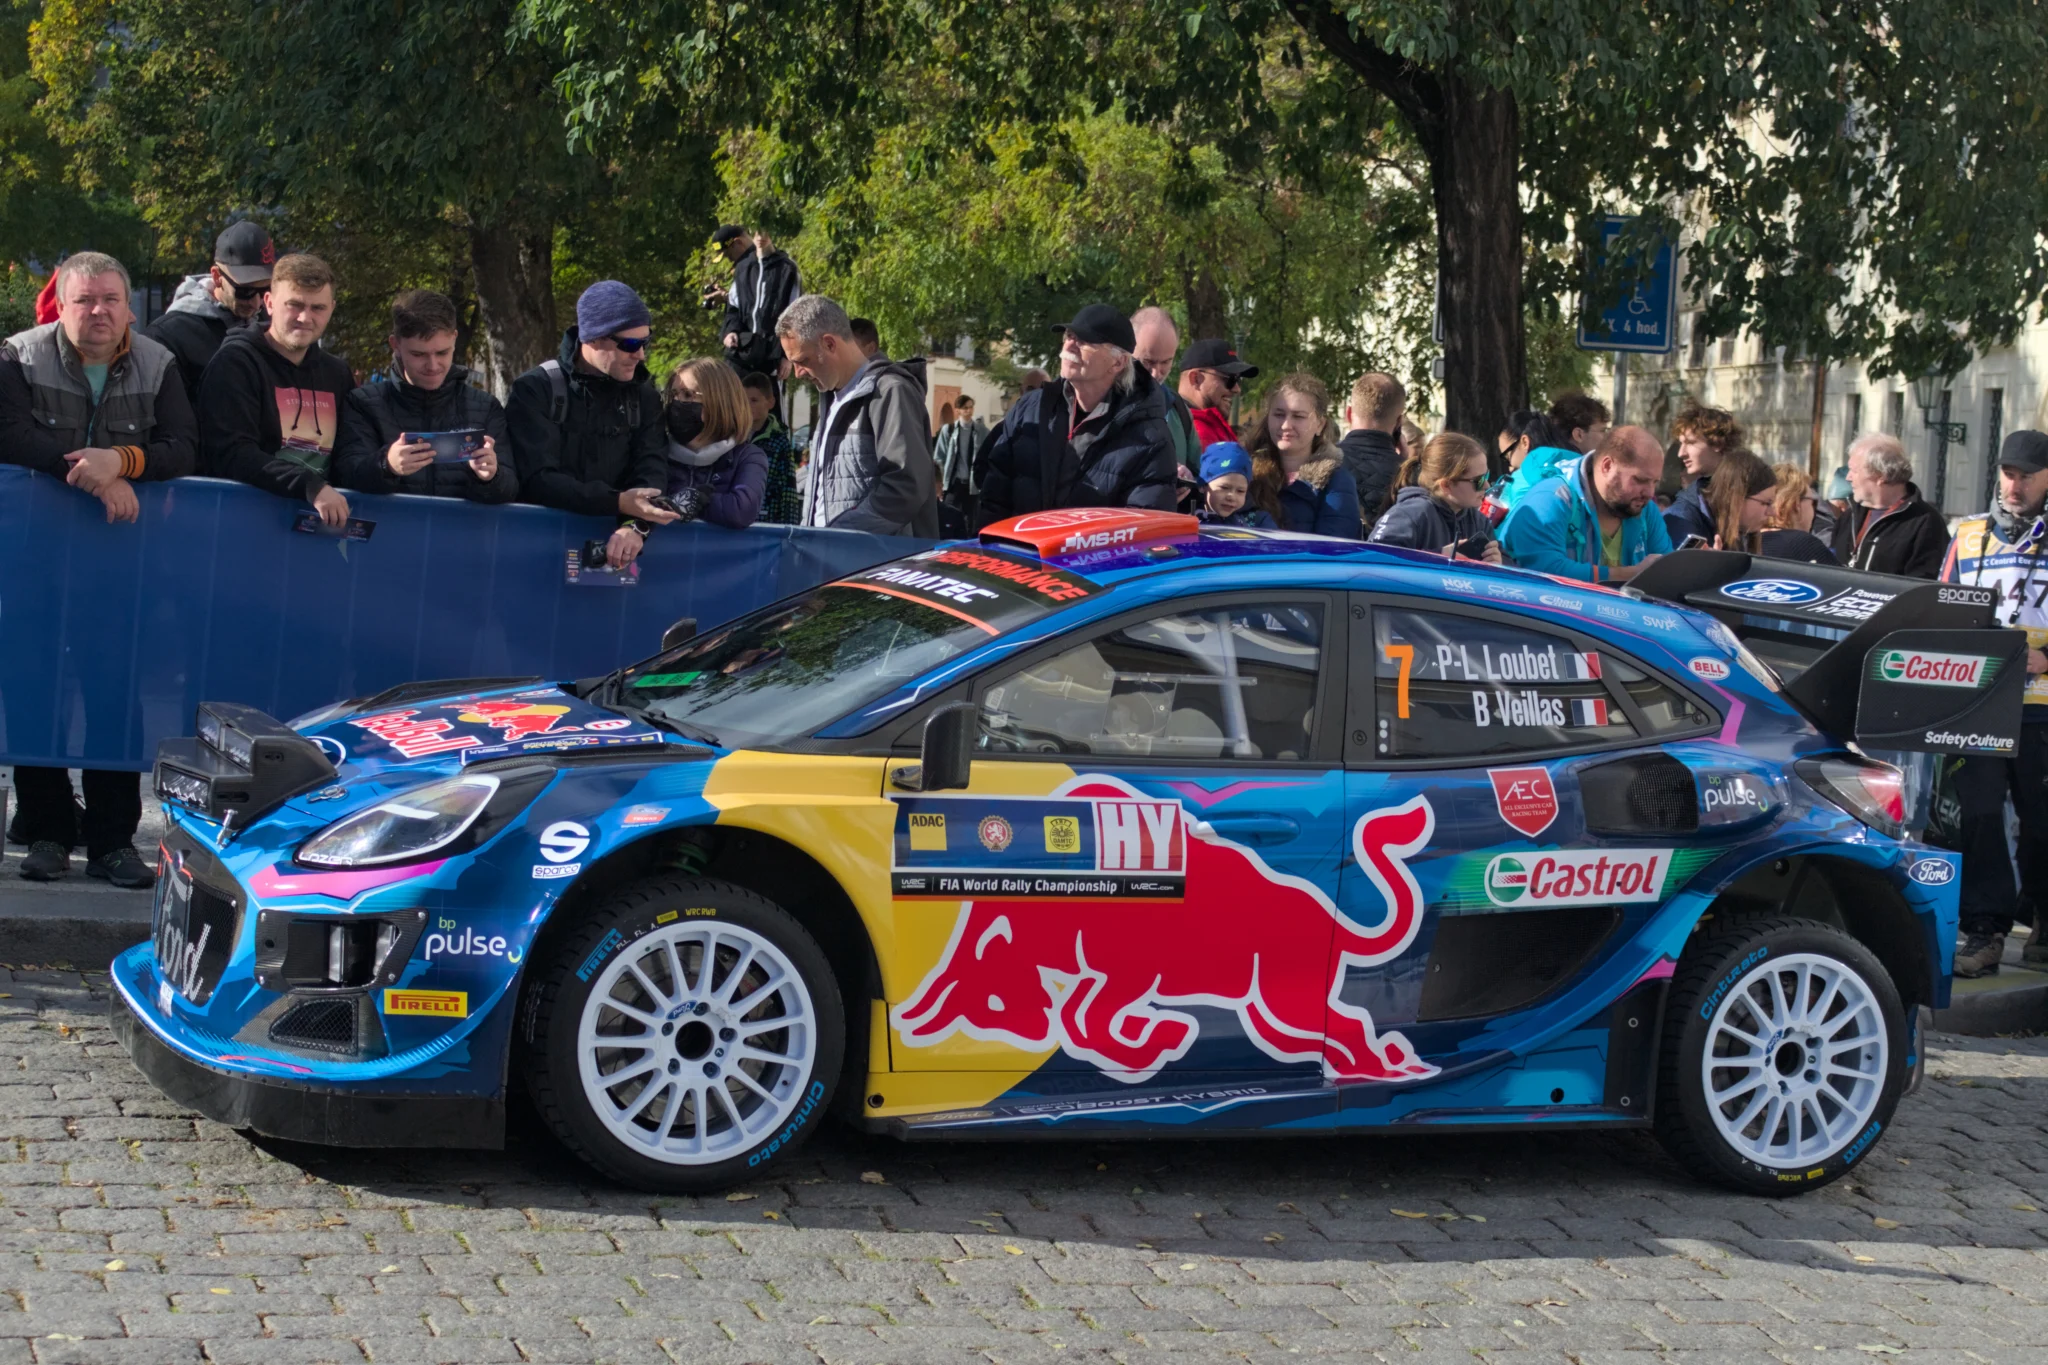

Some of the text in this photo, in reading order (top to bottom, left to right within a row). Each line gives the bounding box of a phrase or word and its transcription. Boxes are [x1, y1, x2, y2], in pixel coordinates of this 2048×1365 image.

[1623, 319, 1632, 333] 4
[1636, 320, 1660, 335] hod.
[1076, 527, 1138, 549] MS-RT
[1990, 557, 2016, 567] Central
[866, 567, 993, 604] FANATEC
[1442, 577, 1474, 590] NGK
[1730, 581, 1807, 602] Ford
[1938, 587, 1991, 604] sparco
[1436, 644, 1560, 681] P-L Loubet
[1693, 661, 1725, 674] BELL
[1905, 655, 1978, 683] Castrol
[1384, 644, 1415, 719] 7
[1472, 690, 1566, 727] B Veillas
[1925, 731, 2014, 749] SafetyCulture
[1503, 779, 1551, 801] AEC
[1708, 774, 1721, 787] bp
[1705, 781, 1756, 812] pulse
[911, 815, 944, 828] ADAC
[1100, 803, 1177, 870] HY
[298, 852, 353, 866] LAZER
[534, 864, 580, 877] sparco
[1530, 855, 1659, 899] Castrol
[1919, 861, 1949, 881] Ford
[939, 878, 1117, 894] FIA World Rally Championship
[438, 916, 456, 931] bp
[425, 926, 507, 961] pulse
[576, 927, 623, 983] PIRELLI
[1700, 946, 1768, 1020] Cinturato
[390, 993, 460, 1012] PIRELLI
[1020, 1087, 1267, 1115] ECOBOOST HYBRID
[748, 1080, 825, 1167] Cinturato
